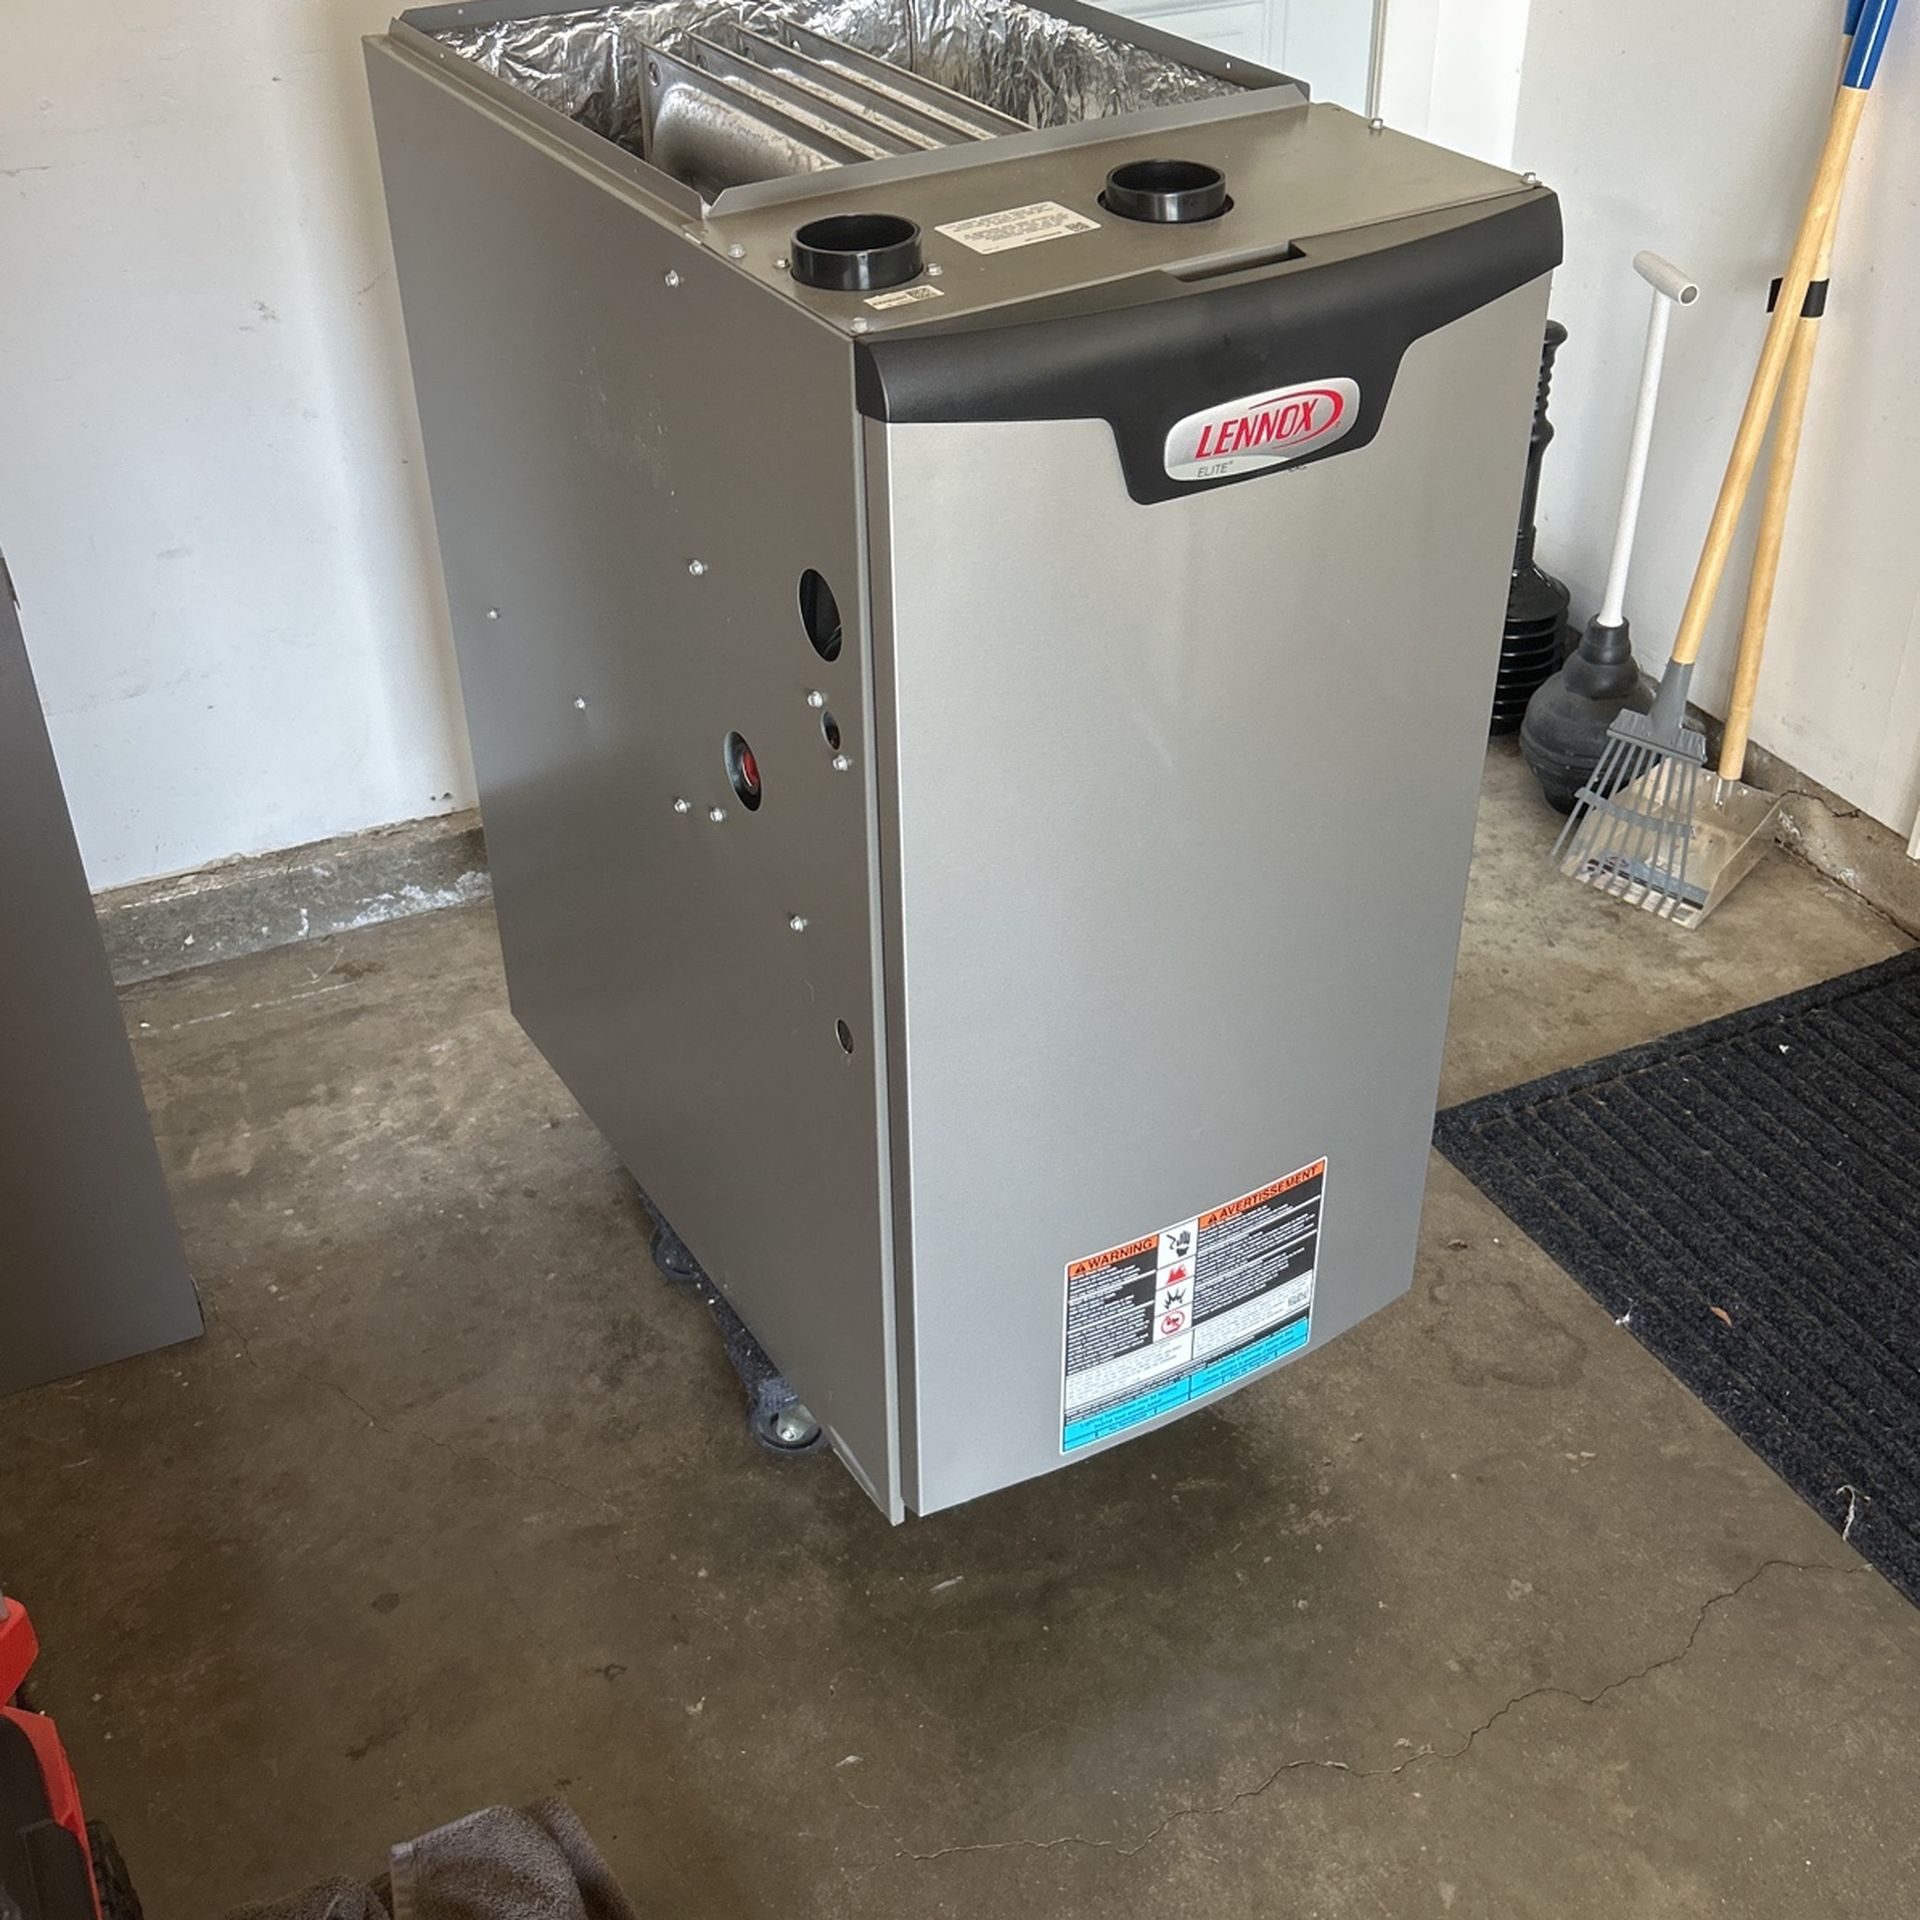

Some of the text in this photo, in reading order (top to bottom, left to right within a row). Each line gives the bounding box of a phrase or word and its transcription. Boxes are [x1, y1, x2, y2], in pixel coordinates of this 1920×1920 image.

[1195, 399, 1318, 459] LENNOX
[1220, 1165, 1318, 1218] AVERTISSEMENT
[1088, 1239, 1153, 1268] WARNING
